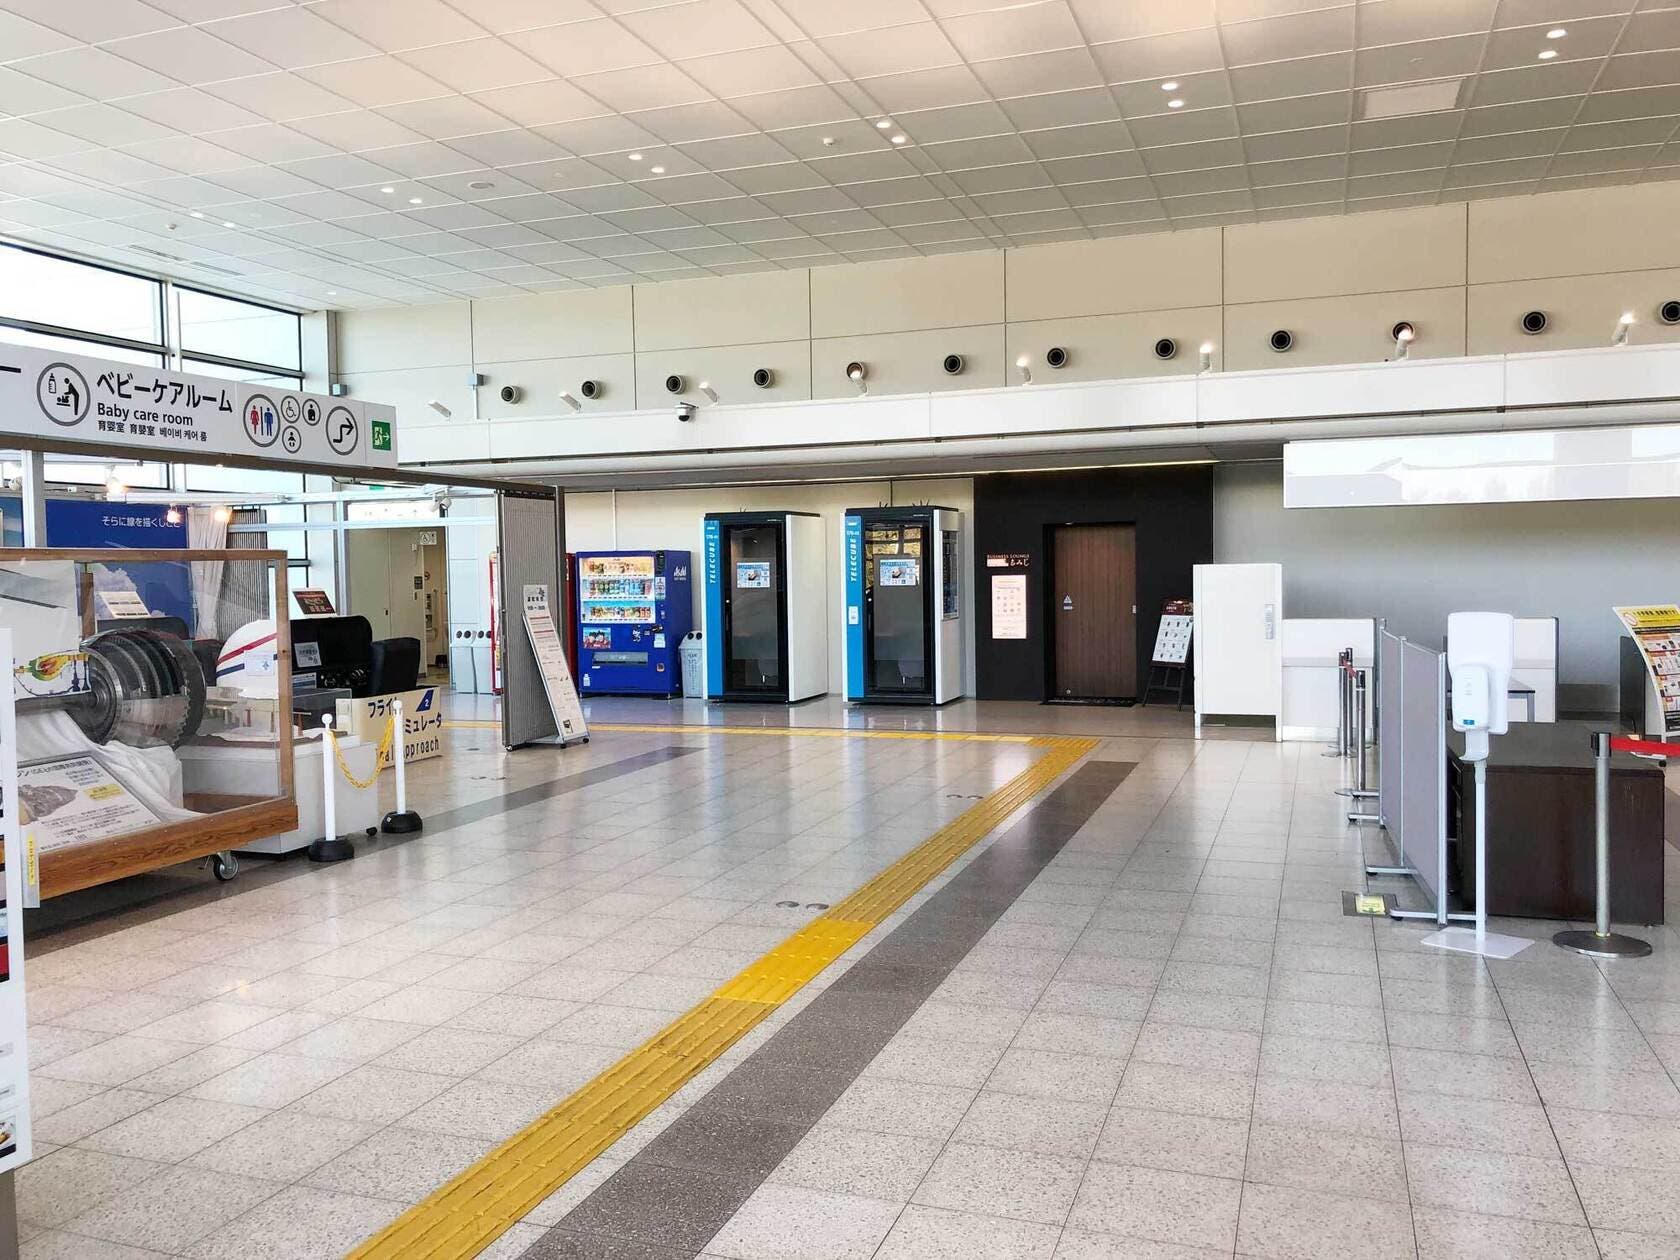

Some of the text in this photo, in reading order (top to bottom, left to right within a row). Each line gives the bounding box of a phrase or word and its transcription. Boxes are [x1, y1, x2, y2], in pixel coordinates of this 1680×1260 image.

[97, 371, 233, 413] ベビーケアルーム
[97, 402, 193, 426] Baby care room
[160, 427, 182, 439] 베이비
[184, 430, 198, 440] 케어
[709, 542, 717, 584] TELECUBE
[368, 696, 397, 718] フライ
[424, 699, 430, 707] 2
[405, 712, 442, 734] ミュレータ
[404, 736, 439, 759] pproach
